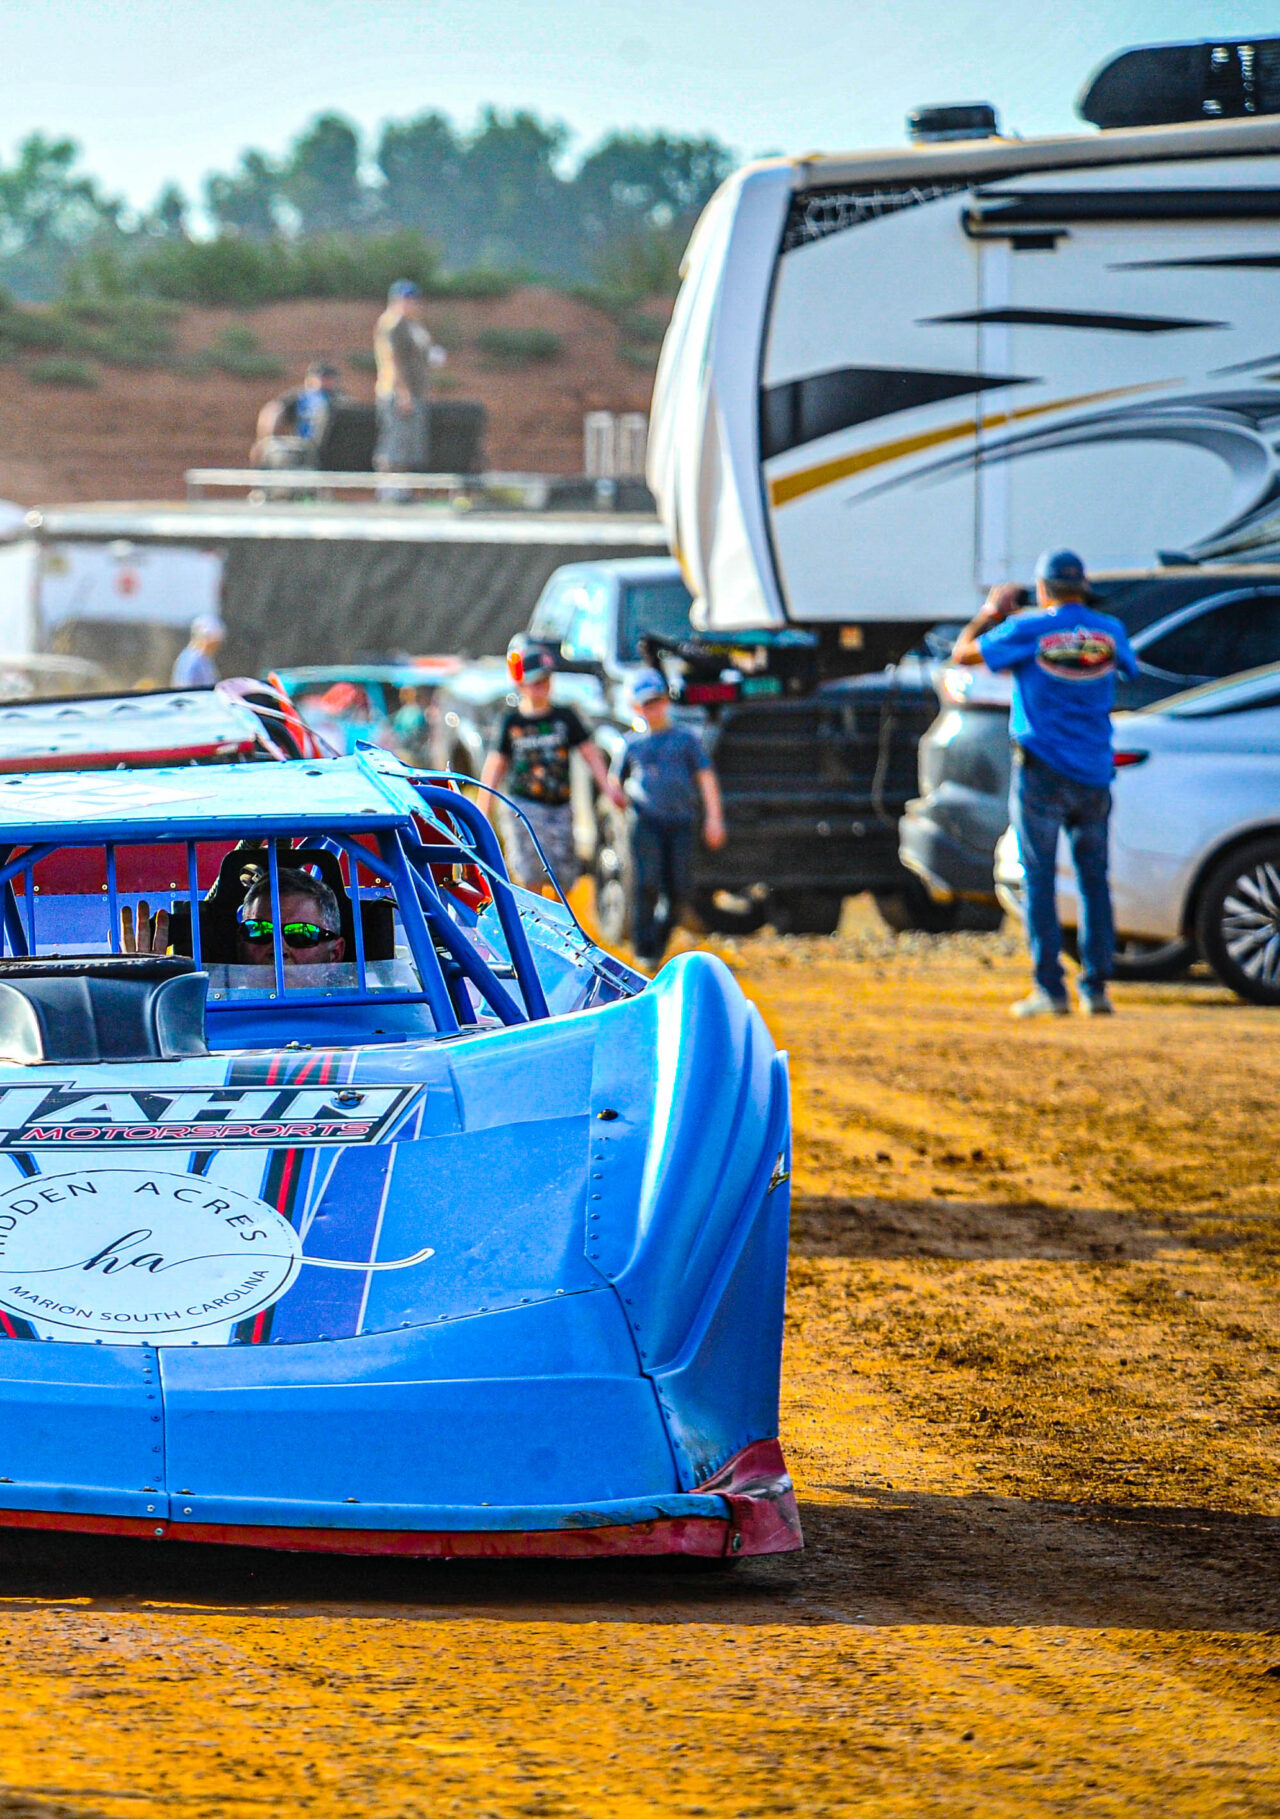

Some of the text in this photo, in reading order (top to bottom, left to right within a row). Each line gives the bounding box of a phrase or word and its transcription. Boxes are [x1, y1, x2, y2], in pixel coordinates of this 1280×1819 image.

[20, 1121, 373, 1141] MOTORSPORTS
[133, 1181, 268, 1243] ACRES
[82, 1228, 167, 1275] ha
[8, 1268, 270, 1323] MARION SOUTH CAROLINA
